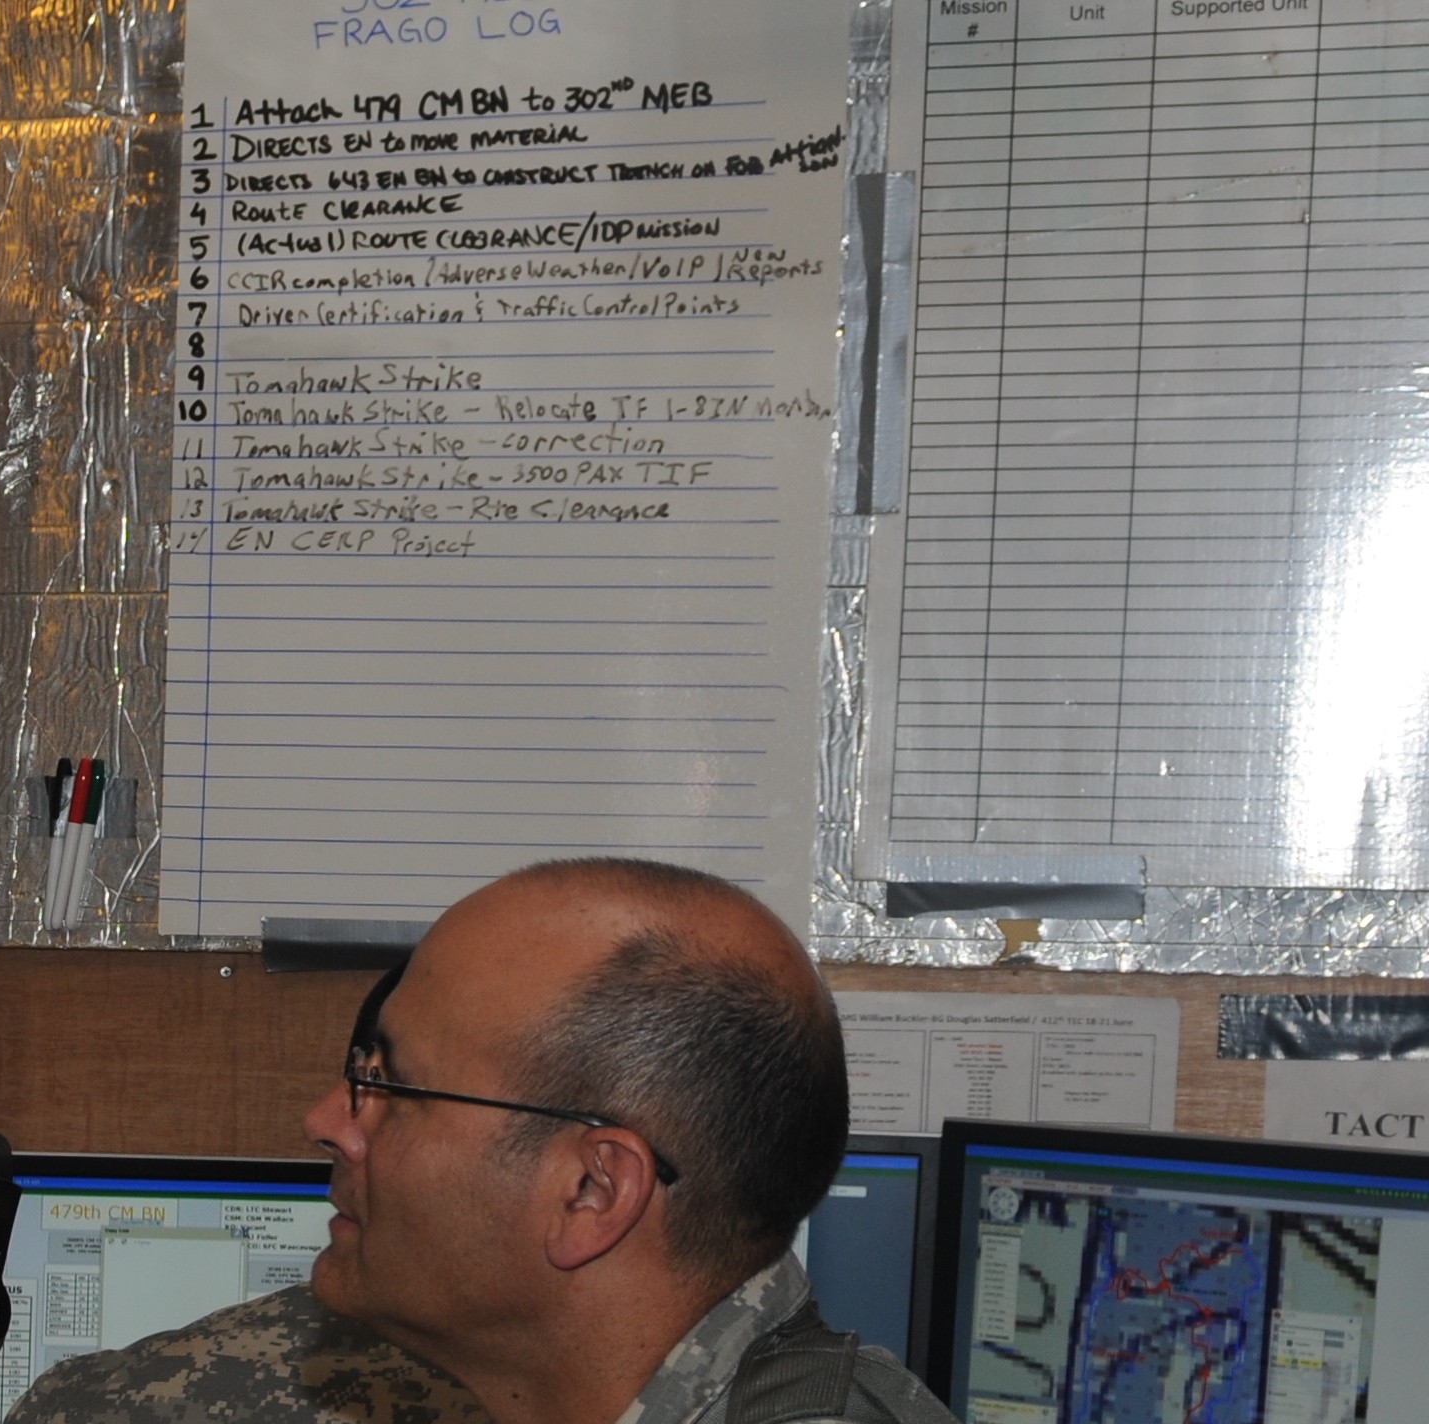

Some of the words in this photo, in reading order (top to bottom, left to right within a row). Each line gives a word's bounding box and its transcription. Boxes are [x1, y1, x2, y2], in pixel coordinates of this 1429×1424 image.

[1069, 5, 1106, 21] Unit
[312, 17, 448, 48] FRAGO
[476, 9, 562, 35] LOG
[966, 23, 979, 38] #
[190, 102, 214, 129] 1
[235, 98, 342, 125] Attach
[353, 94, 401, 122] 479
[418, 89, 464, 120] CM
[470, 86, 509, 113] BN
[522, 86, 555, 111] to
[641, 81, 713, 113] MEB
[192, 137, 217, 161] 2
[230, 134, 333, 163] DIRECTS
[343, 131, 373, 150] EN
[381, 134, 406, 152] to
[410, 132, 459, 151] move
[191, 169, 210, 193] 3
[328, 169, 369, 191] 643
[190, 202, 206, 226] 4
[190, 235, 210, 260] 5
[353, 230, 427, 250] ROUTE
[191, 266, 209, 289] 6
[227, 271, 287, 292] CCIR
[292, 268, 416, 296] completion
[188, 302, 207, 326] 7
[239, 303, 308, 327] Driver
[317, 300, 464, 326] Certification
[583, 292, 659, 317] Control
[188, 332, 205, 357] 8
[188, 365, 205, 391] 9
[226, 365, 371, 395] Tomahawk
[378, 363, 483, 391] Strike
[179, 400, 207, 422] 10
[228, 395, 354, 425] Tomahawk
[363, 399, 448, 423] Strike
[182, 438, 203, 461] 11
[233, 433, 361, 459] Tomahawk
[369, 427, 471, 461] Strike
[185, 467, 208, 490] 12
[234, 467, 375, 492] Tomahawk
[383, 461, 484, 491] Strike
[513, 462, 567, 484] 3500
[575, 460, 623, 486] PAX
[636, 461, 713, 486] TIF
[179, 499, 203, 519] 13
[226, 526, 274, 550] EN
[391, 529, 476, 558] Project
[1325, 1111, 1425, 1138] TACT
[49, 1204, 101, 1221] 479th
[107, 1205, 135, 1222] CM
[142, 1206, 166, 1223] BN
